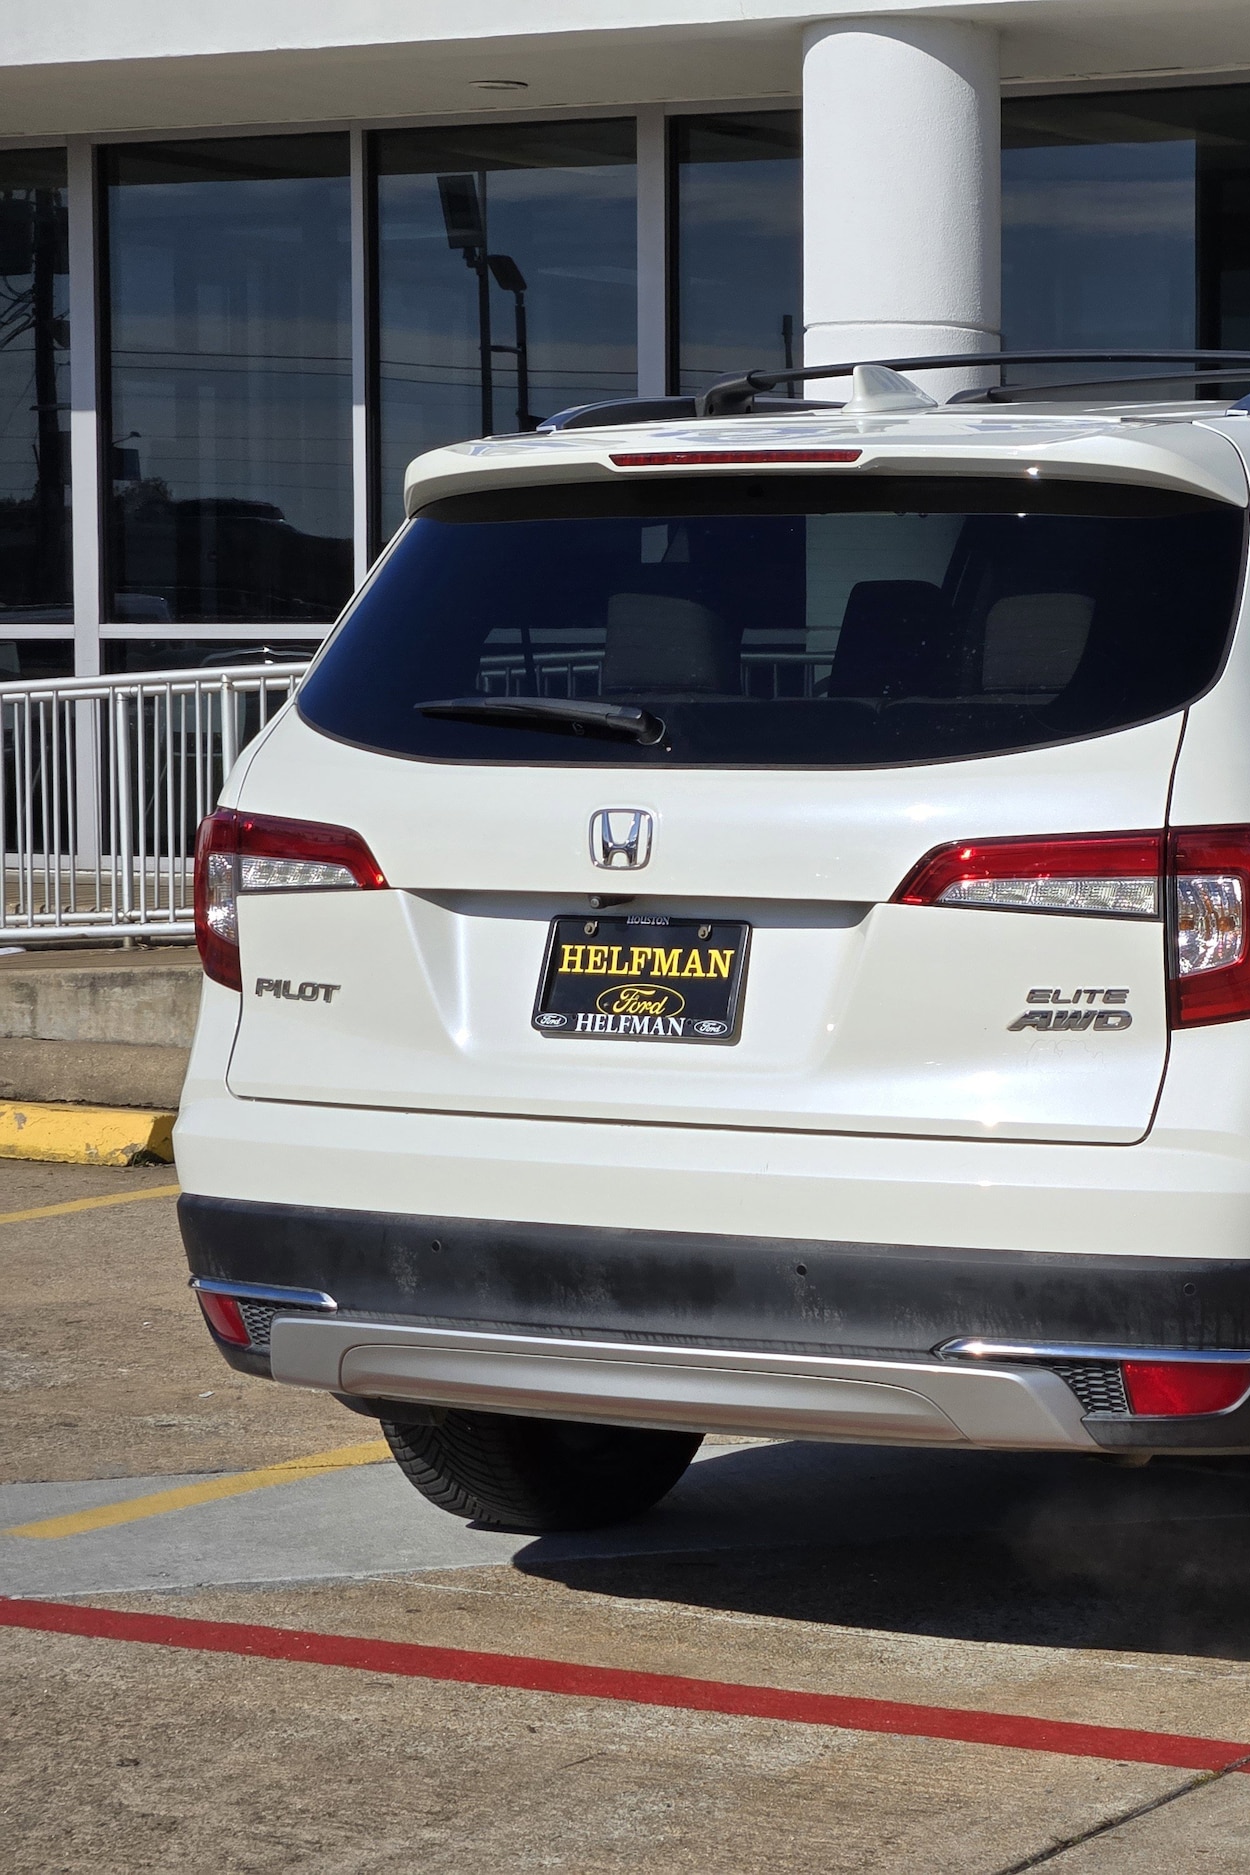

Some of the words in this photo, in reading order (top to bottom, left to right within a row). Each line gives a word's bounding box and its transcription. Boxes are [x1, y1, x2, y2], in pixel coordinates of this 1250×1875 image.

[626, 915, 671, 926] HOUSTON
[558, 944, 735, 978] HELFMAN
[255, 977, 342, 1004] PILOT
[612, 988, 669, 1015] Ford
[1025, 988, 1130, 1004] ELITE
[540, 1014, 562, 1026] Ford
[575, 1012, 686, 1037] HELFMAN
[699, 1021, 722, 1034] Ford
[1006, 1009, 1133, 1032] AWD
